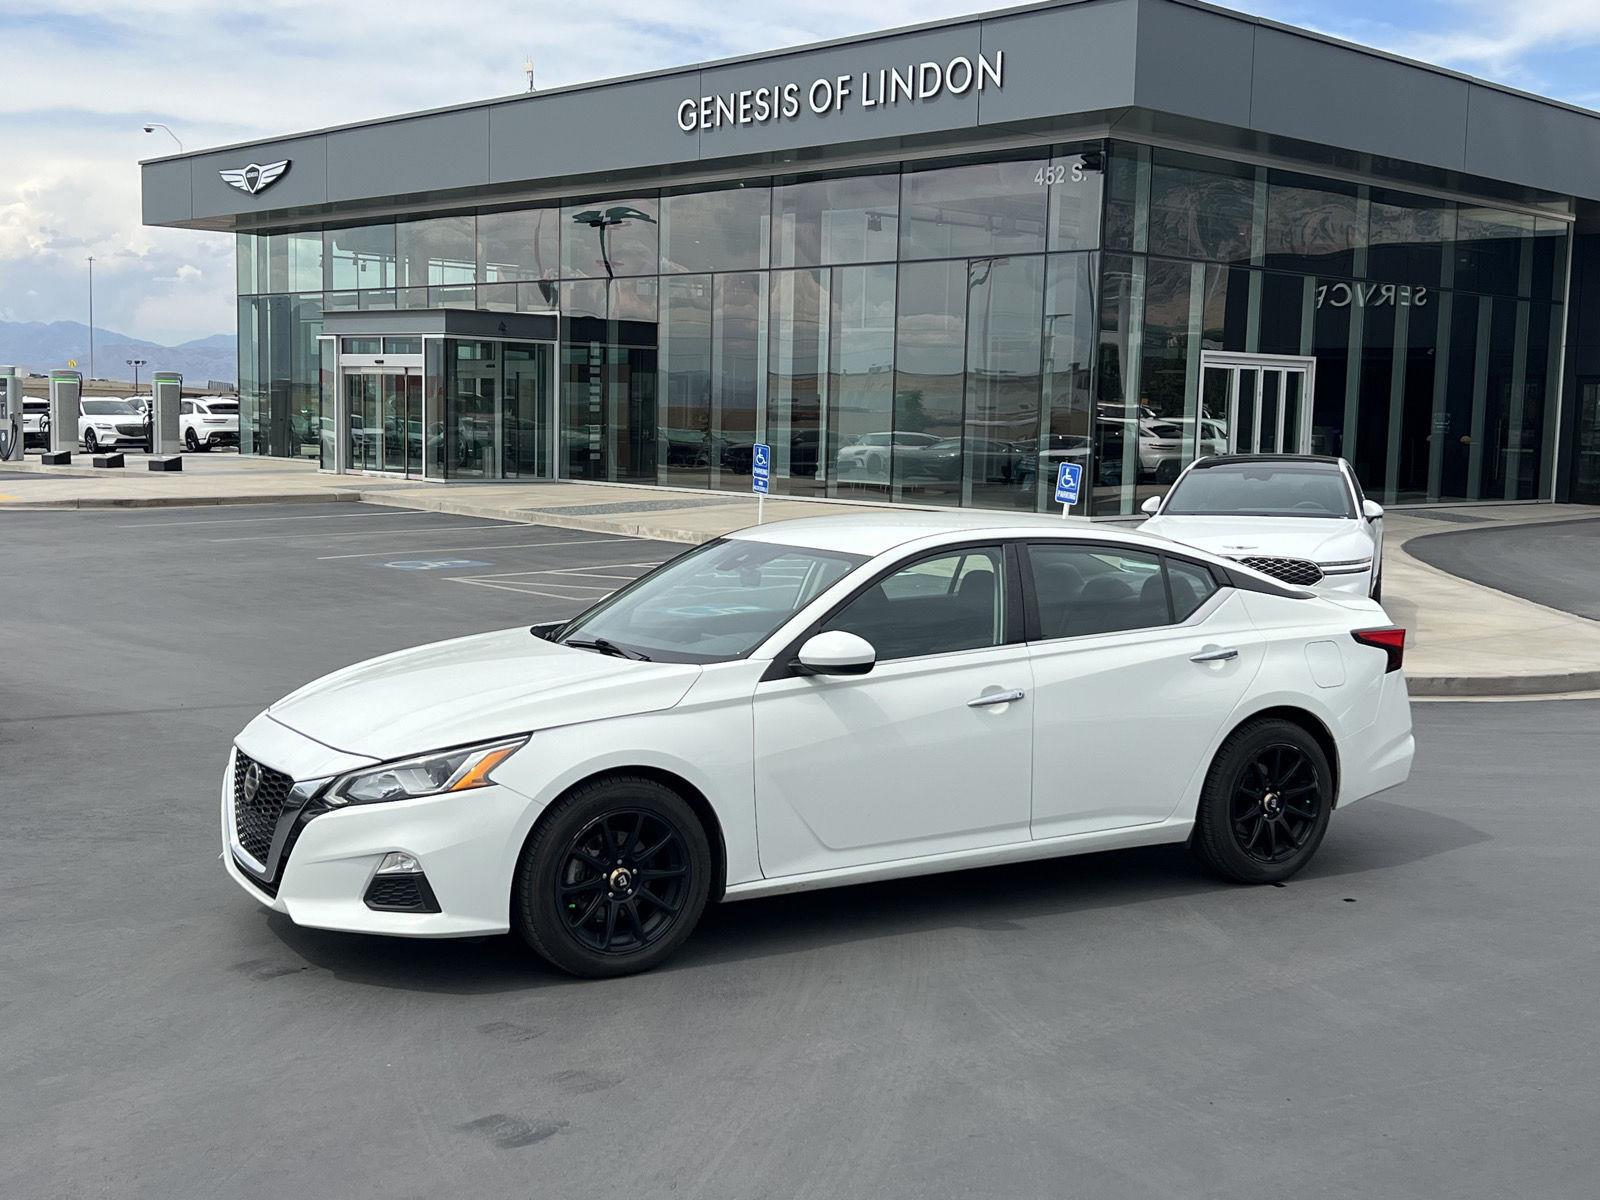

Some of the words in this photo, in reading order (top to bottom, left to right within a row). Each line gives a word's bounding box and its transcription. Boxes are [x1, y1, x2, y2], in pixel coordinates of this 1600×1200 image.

[677, 83, 801, 132] GENESIS
[808, 75, 852, 114] OF
[861, 50, 1004, 107] LINDON
[1034, 165, 1066, 186] 452
[1071, 163, 1087, 182] S.
